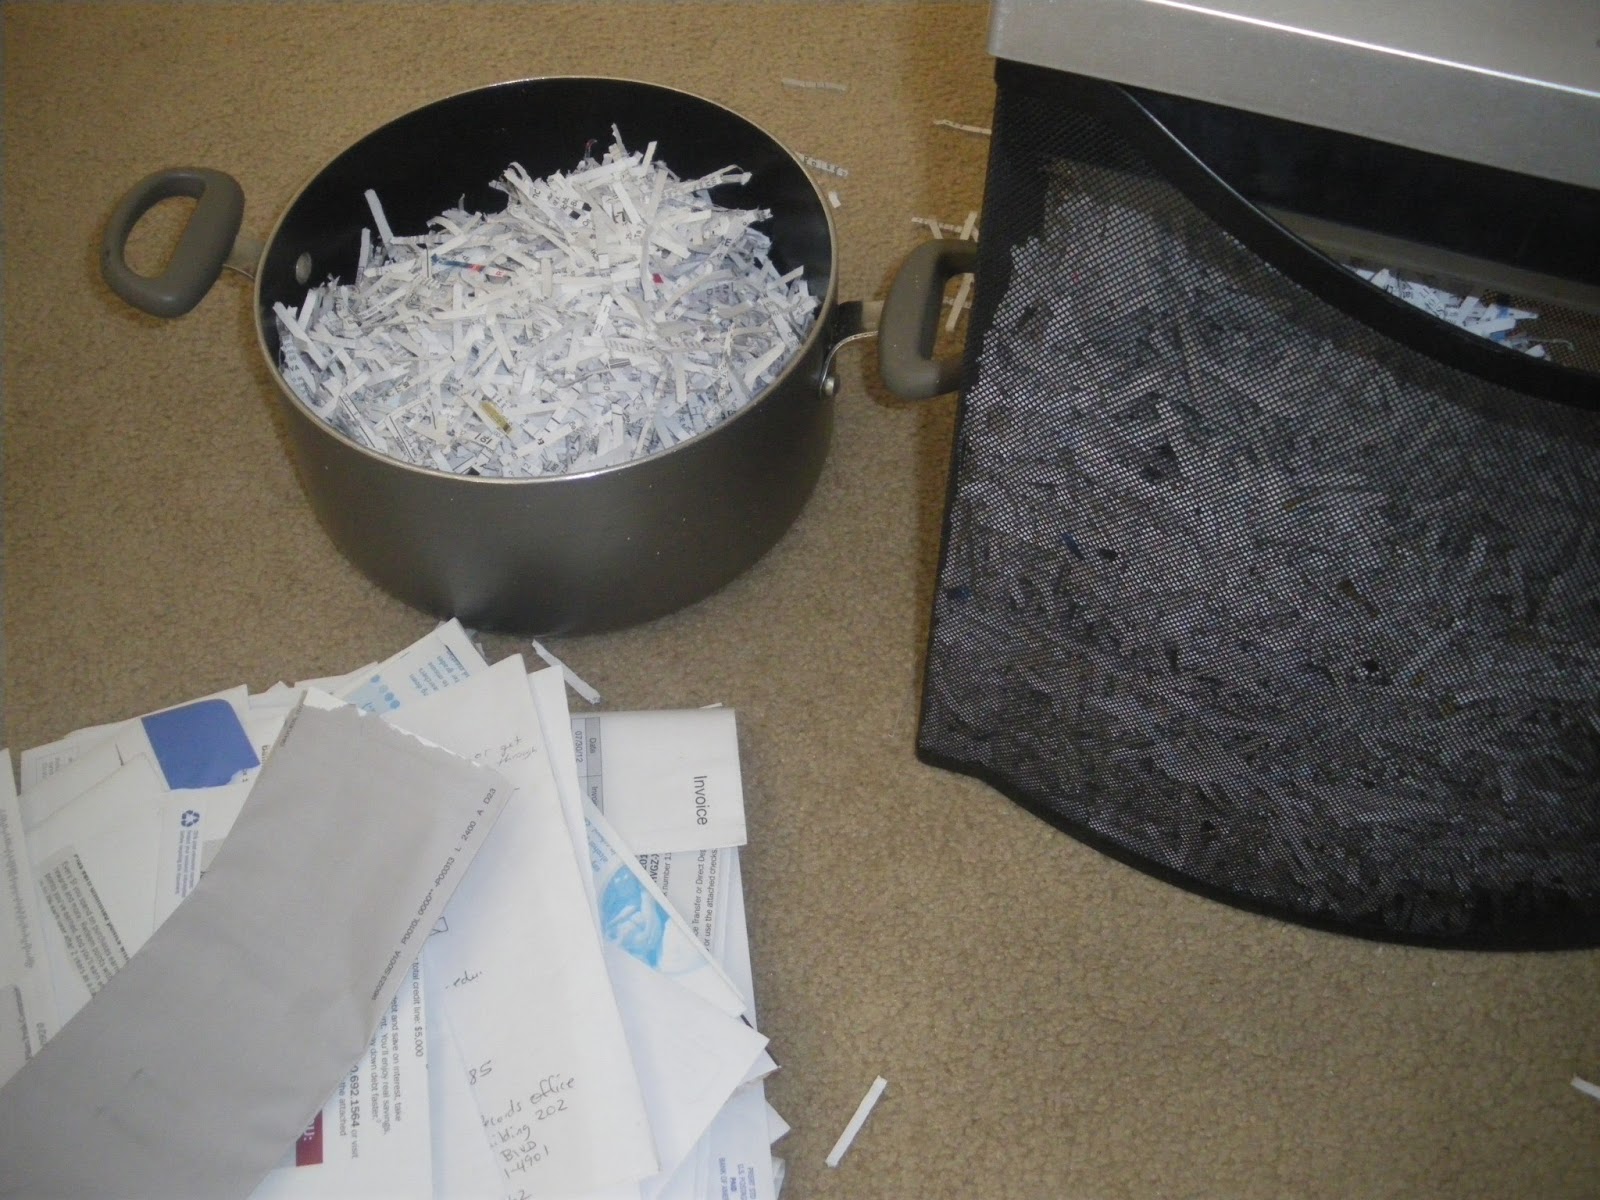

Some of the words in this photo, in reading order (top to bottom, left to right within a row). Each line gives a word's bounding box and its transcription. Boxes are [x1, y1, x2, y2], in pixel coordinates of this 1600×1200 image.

[574, 730, 582, 762] 07/30/12
[693, 775, 710, 825] Invoice
[461, 820, 477, 841] 2400
[484, 788, 497, 805] D23
[662, 862, 670, 889] number
[695, 863, 704, 884] Direct
[706, 875, 715, 907] attached
[692, 895, 701, 923] Transfer
[412, 981, 420, 1004] credit
[390, 1014, 398, 1030] and
[413, 1006, 421, 1023] line:
[412, 1025, 423, 1057] $5,000
[369, 1048, 378, 1070] down
[379, 1057, 388, 1079] enjoy
[392, 1052, 398, 1063] on
[370, 1072, 378, 1091] debt
[338, 1098, 347, 1135] attached
[535, 1099, 568, 1120] 202
[351, 1129, 357, 1138] or
[351, 1140, 359, 1158] visit
